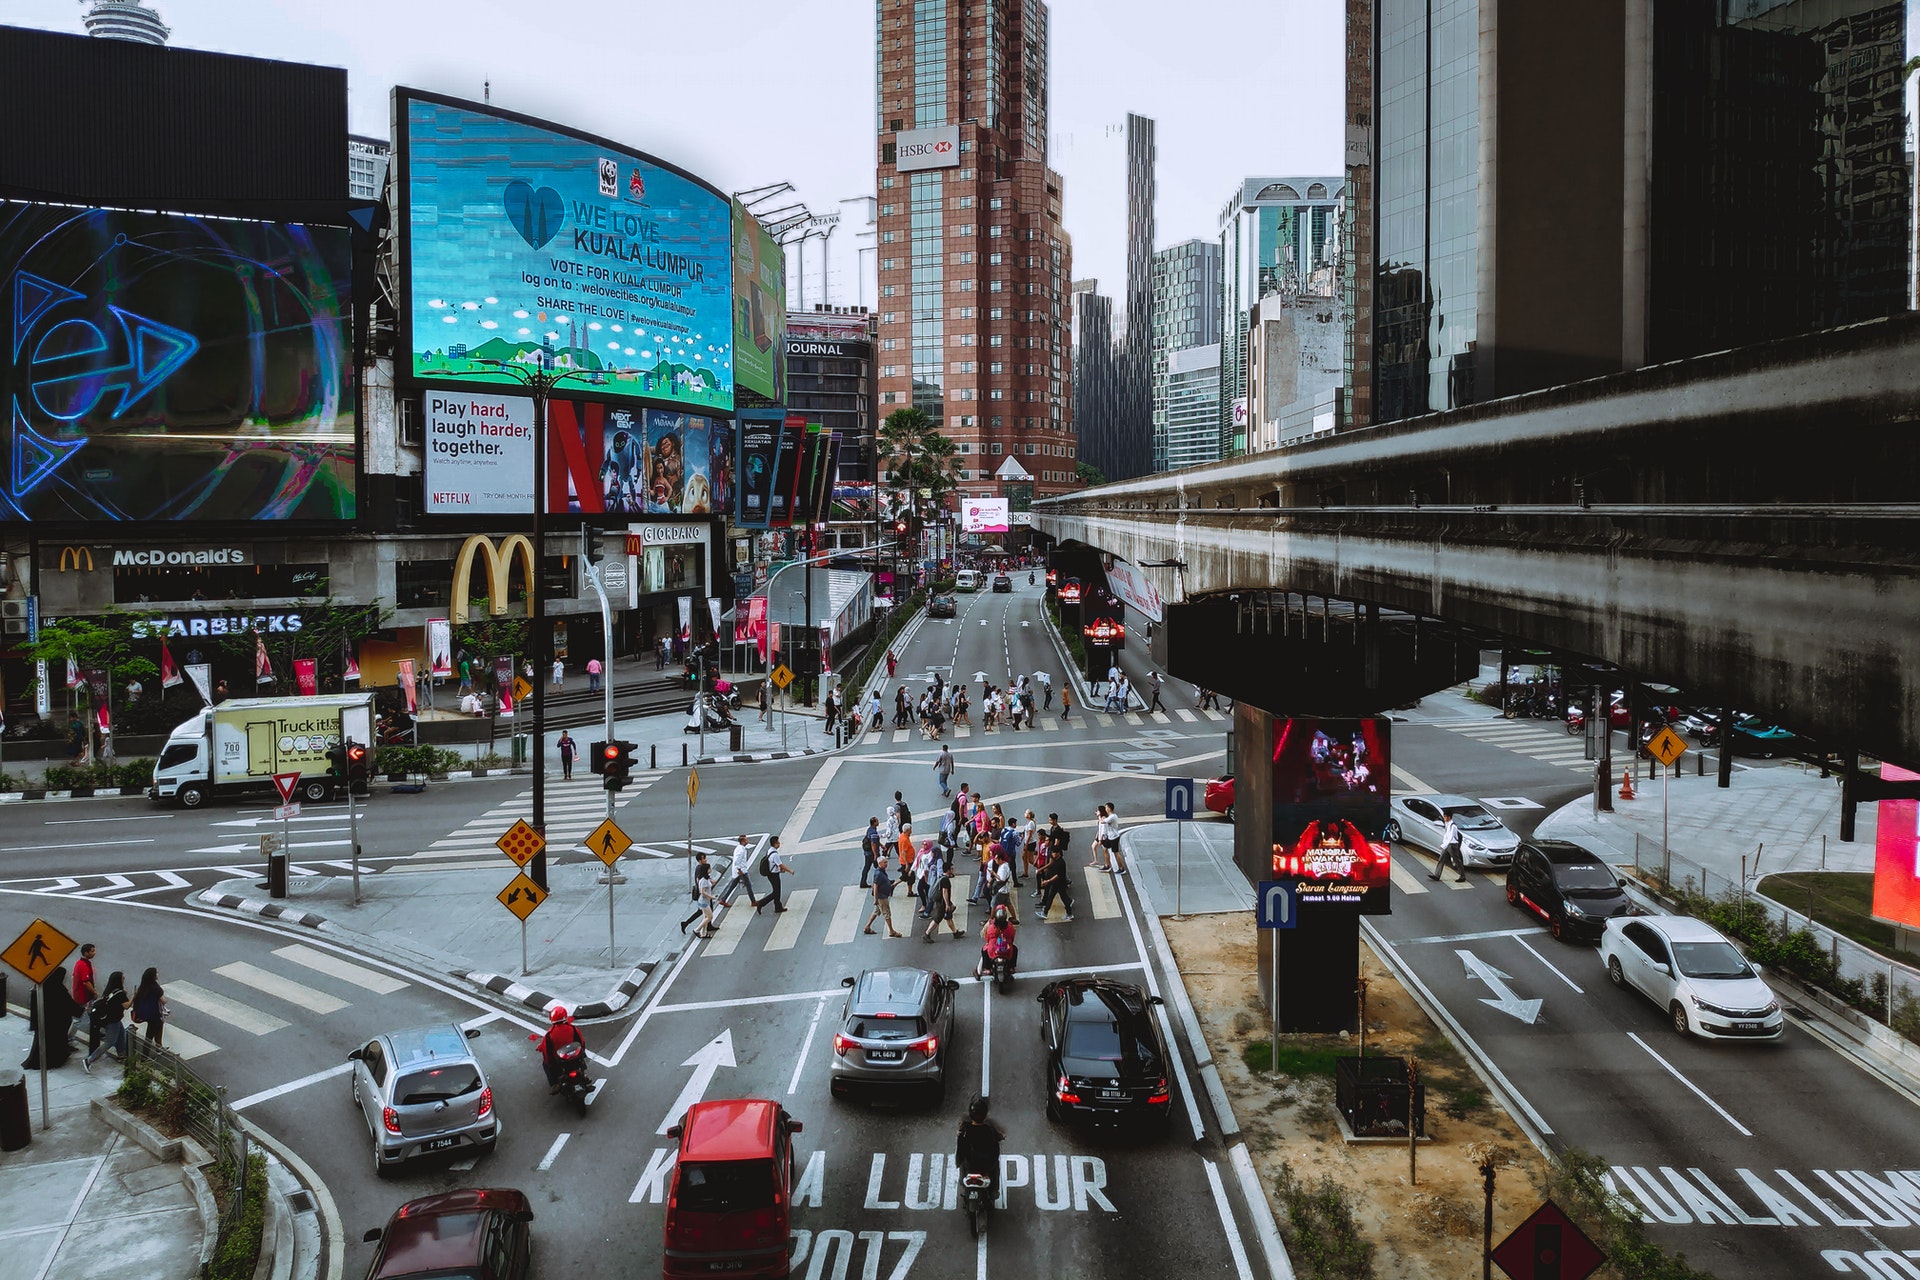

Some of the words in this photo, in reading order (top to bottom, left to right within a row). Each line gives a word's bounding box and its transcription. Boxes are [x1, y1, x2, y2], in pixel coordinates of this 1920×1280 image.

[899, 143, 933, 157] HSBC
[601, 185, 616, 195] WWF
[572, 200, 607, 230] WE
[613, 210, 660, 244] LOVE
[810, 216, 840, 227] ISTANA
[574, 228, 643, 265] KUALA
[646, 246, 704, 283] LUMPUR
[551, 258, 584, 277] VOTE
[587, 266, 610, 282] FOR
[613, 271, 647, 290] KUALA
[648, 280, 682, 299] LUMPUR
[521, 271, 541, 288] log
[544, 275, 559, 288] on
[561, 278, 572, 290] to
[581, 283, 697, 317] welovecities.org/kualalumpur
[537, 296, 575, 312] SHARE
[578, 302, 598, 316] THE
[600, 306, 625, 321] LOVE
[787, 343, 843, 355] JOURNAL
[432, 399, 467, 419] Play
[471, 401, 509, 421] hard,
[610, 412, 632, 421] NEXT
[432, 418, 476, 438] laugh
[480, 421, 532, 441] harder,
[616, 420, 635, 429] GEN
[432, 439, 503, 457] together.
[433, 492, 471, 504] NETFLIX
[1007, 514, 1024, 522] SBC
[643, 527, 700, 542] GIORDANO
[112, 548, 245, 566] McDonald's
[132, 614, 303, 639] STARBUCKS
[224, 743, 240, 751] 700
[1295, 882, 1324, 894] Siaran
[1327, 882, 1369, 894] Langsung
[437, 1139, 452, 1148] 7544
